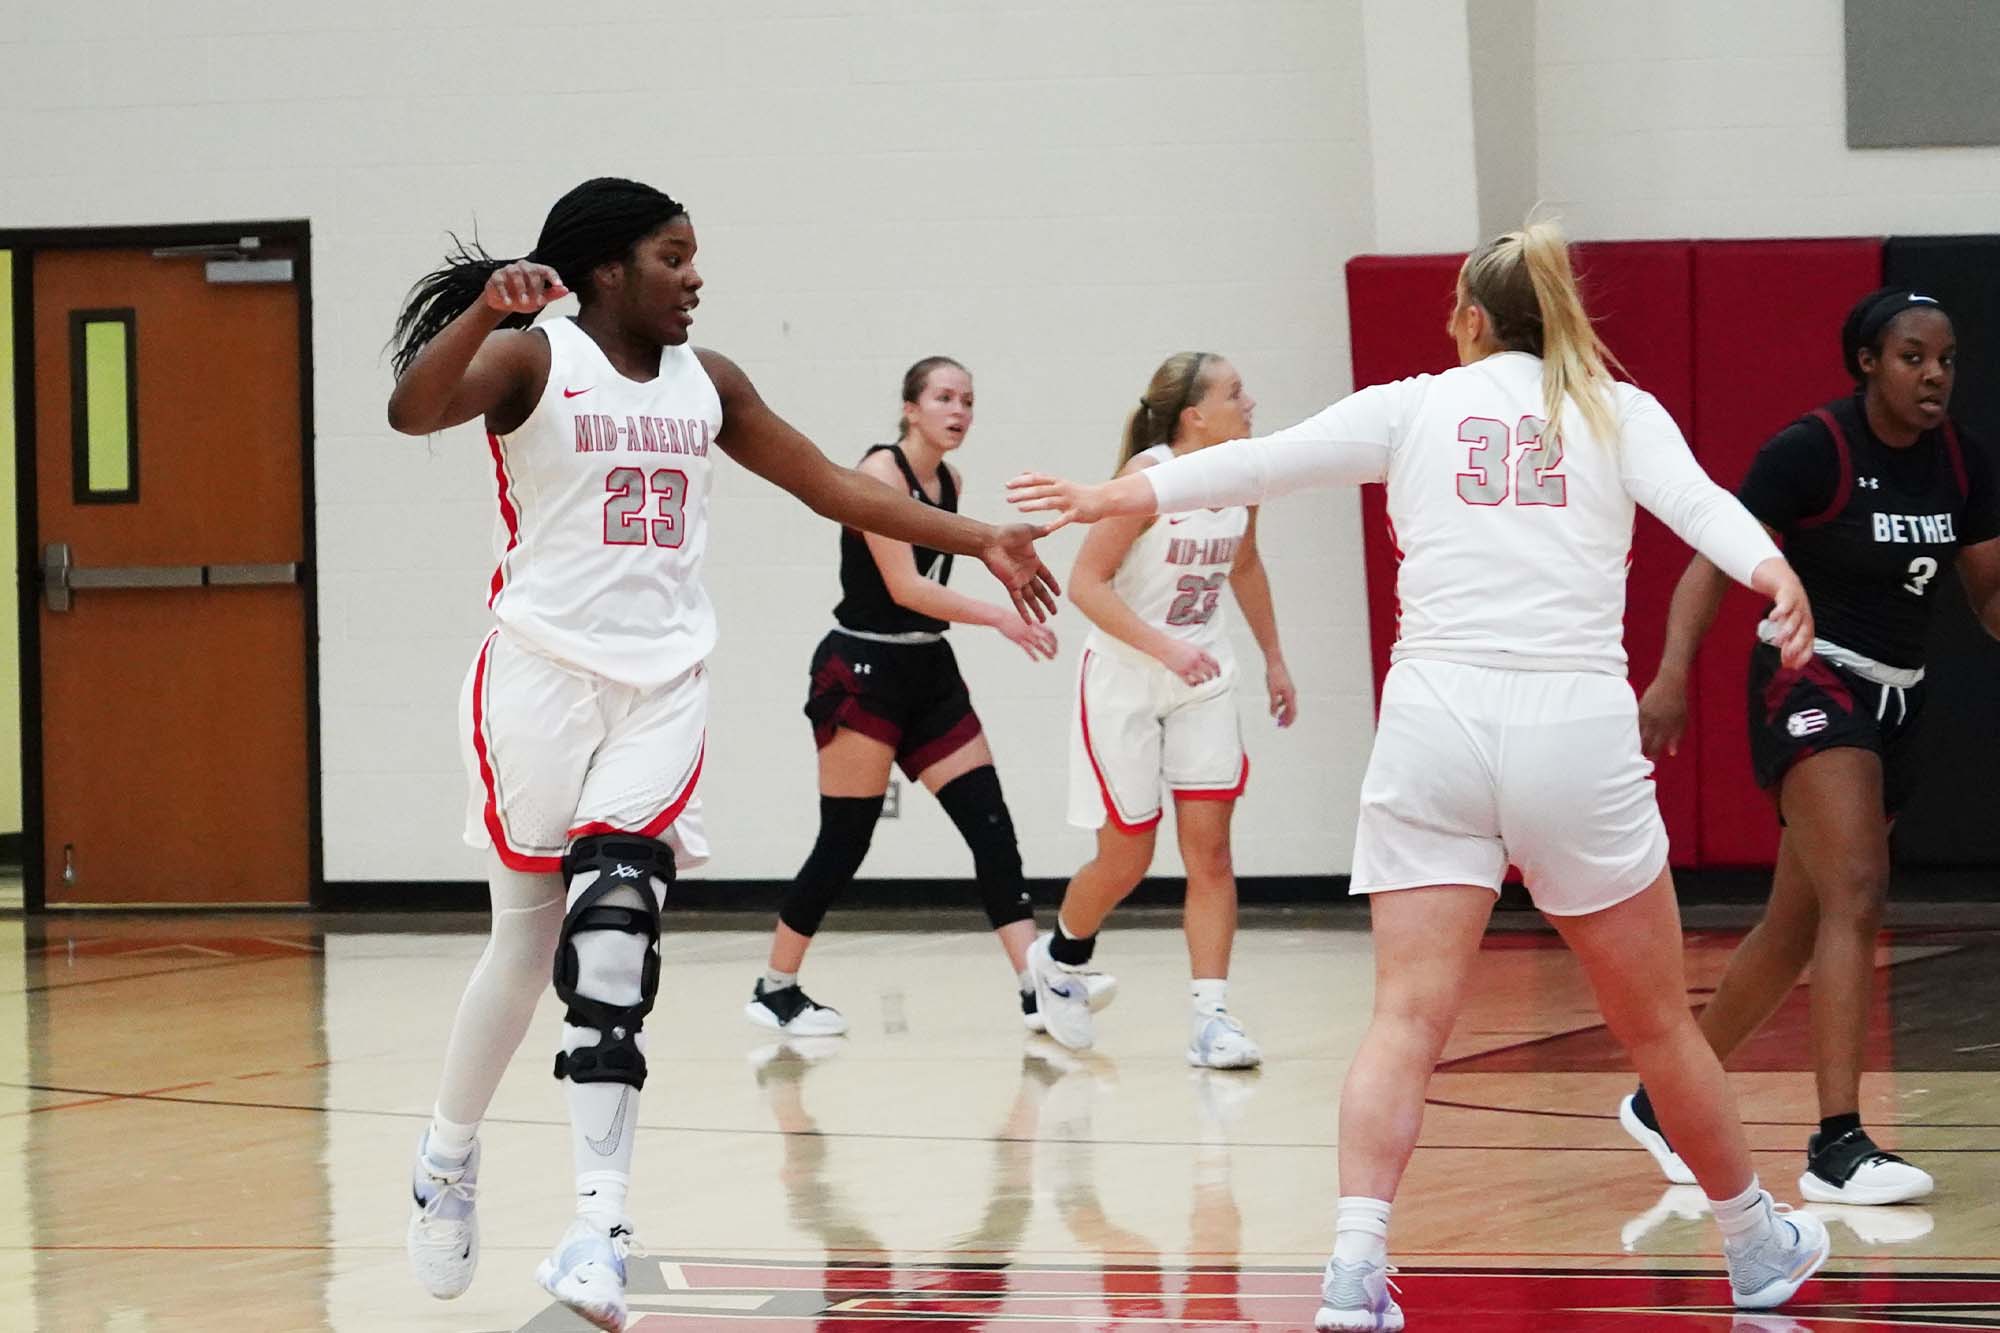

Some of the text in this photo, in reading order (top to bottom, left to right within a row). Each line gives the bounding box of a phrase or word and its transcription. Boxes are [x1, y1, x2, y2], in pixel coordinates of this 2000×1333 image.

[1456, 415, 1567, 507] 32
[603, 467, 689, 549] 23
[1872, 512, 1957, 543] BETHEL
